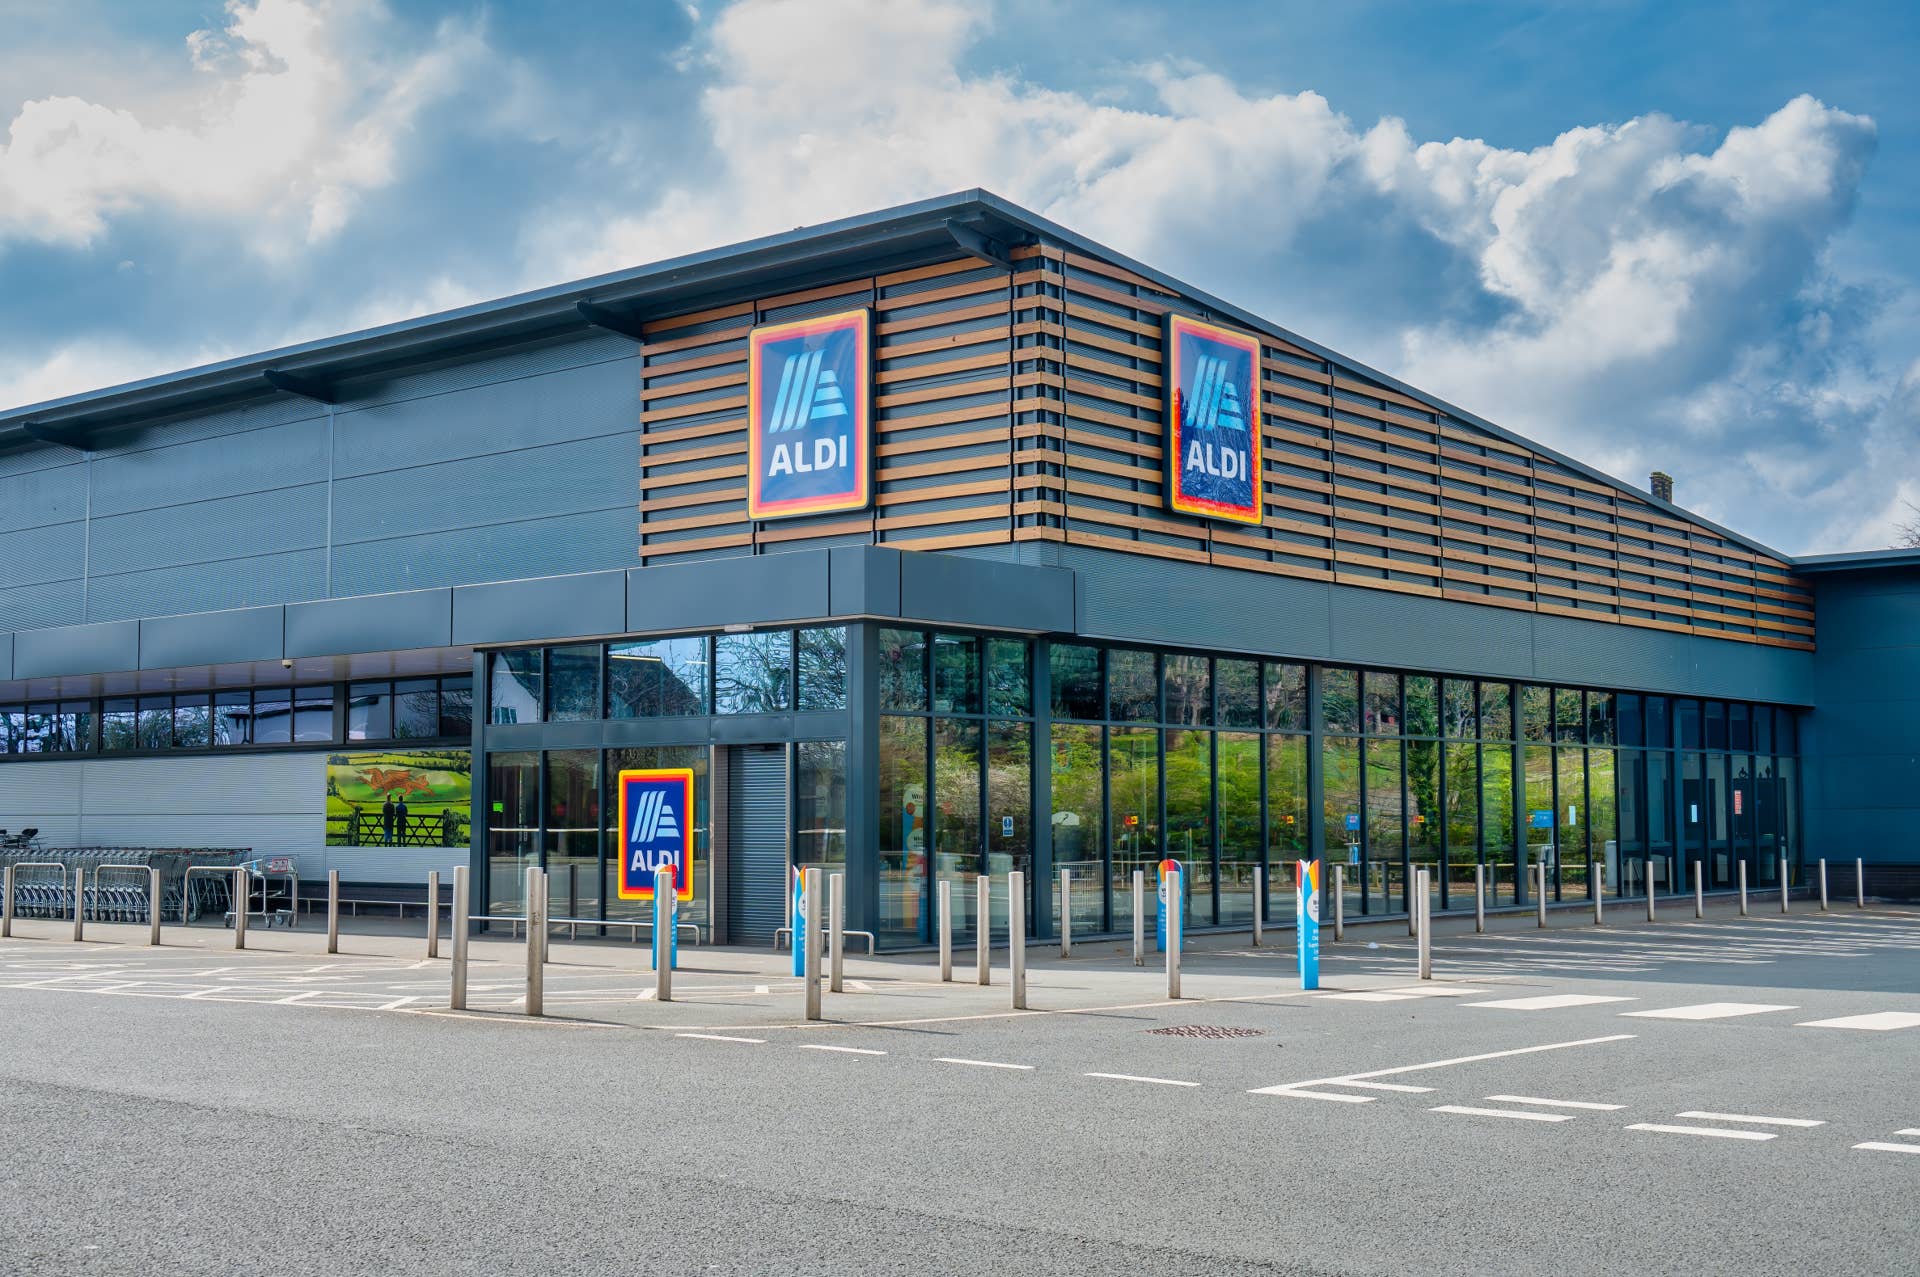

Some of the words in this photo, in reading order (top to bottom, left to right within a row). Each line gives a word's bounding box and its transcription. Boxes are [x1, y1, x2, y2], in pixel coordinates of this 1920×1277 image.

[768, 435, 847, 476] ALDI
[1187, 440, 1246, 481] ALDI
[631, 850, 679, 871] ALDI
